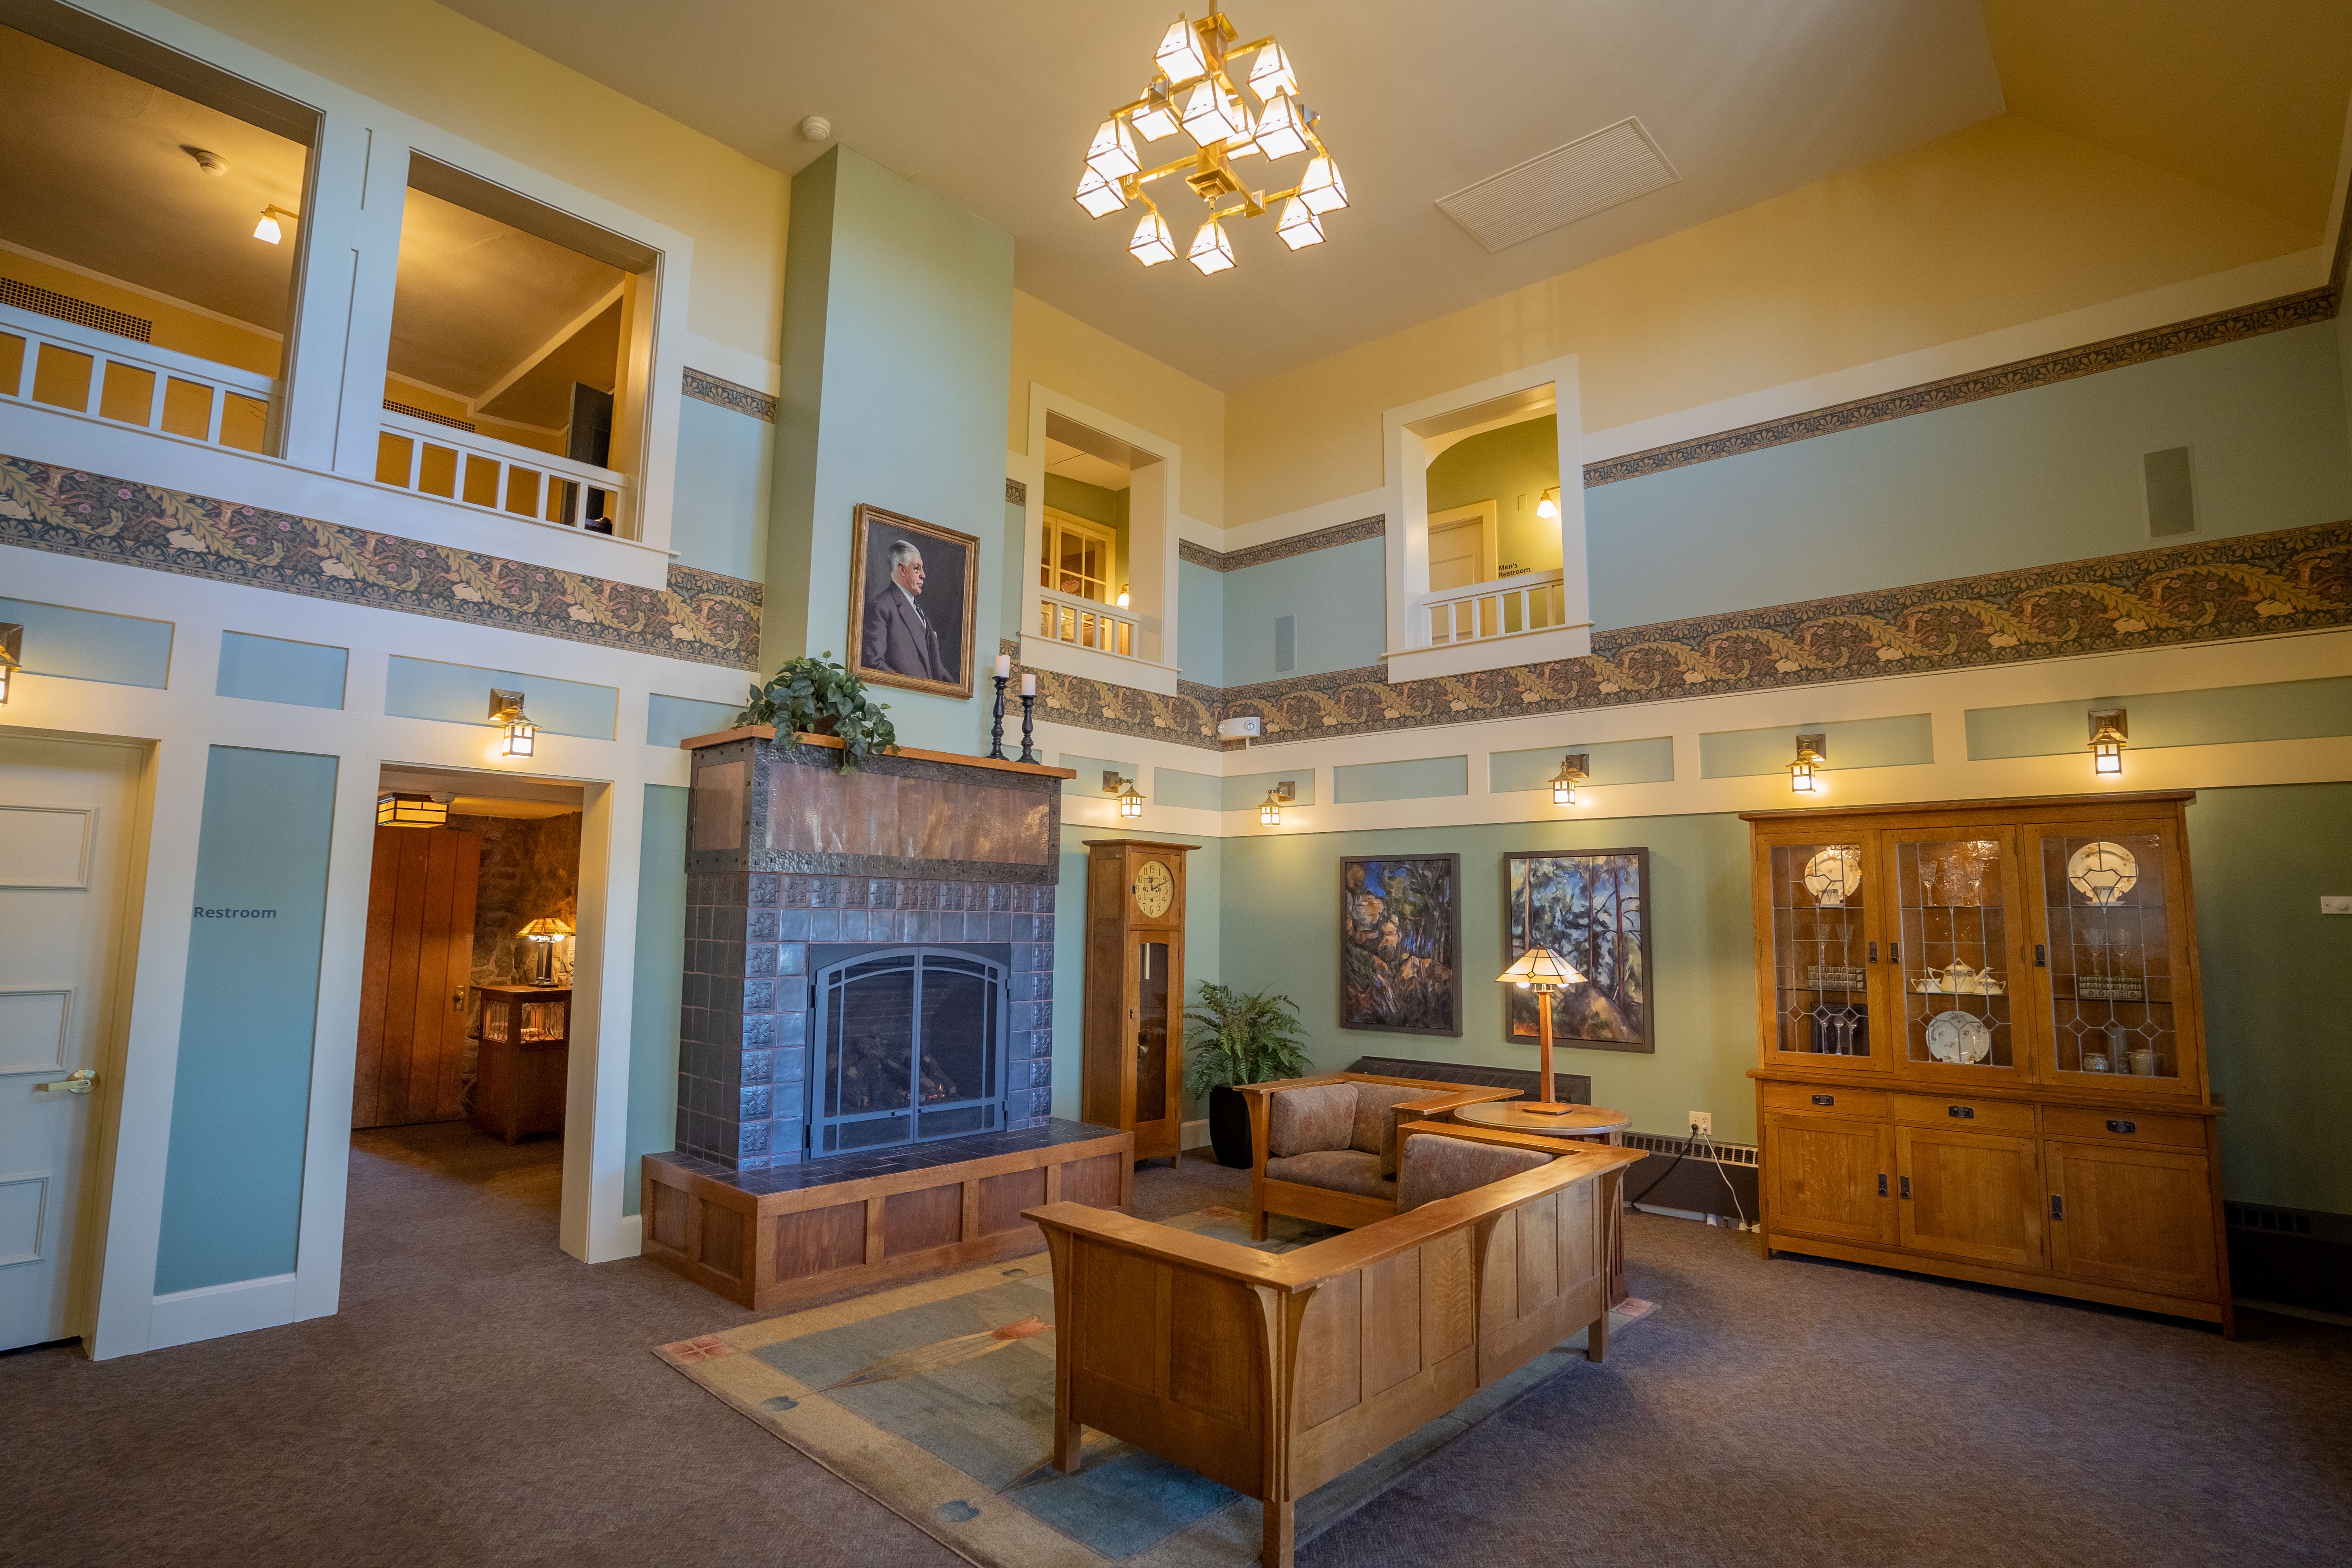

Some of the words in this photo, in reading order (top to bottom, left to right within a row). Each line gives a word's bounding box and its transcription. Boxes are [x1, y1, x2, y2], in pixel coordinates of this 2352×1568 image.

[1499, 563, 1518, 571] Men's
[1499, 567, 1530, 578] Restroom
[1143, 867, 1147, 876] 11
[1150, 865, 1155, 873] 12
[1137, 875, 1143, 883] 10
[1136, 884, 1139, 893] 9
[1138, 895, 1141, 903] 8
[1142, 903, 1146, 911] 7
[1150, 906, 1153, 914] 6
[1157, 903, 1160, 911] 5
[194, 907, 276, 918] Restroom
